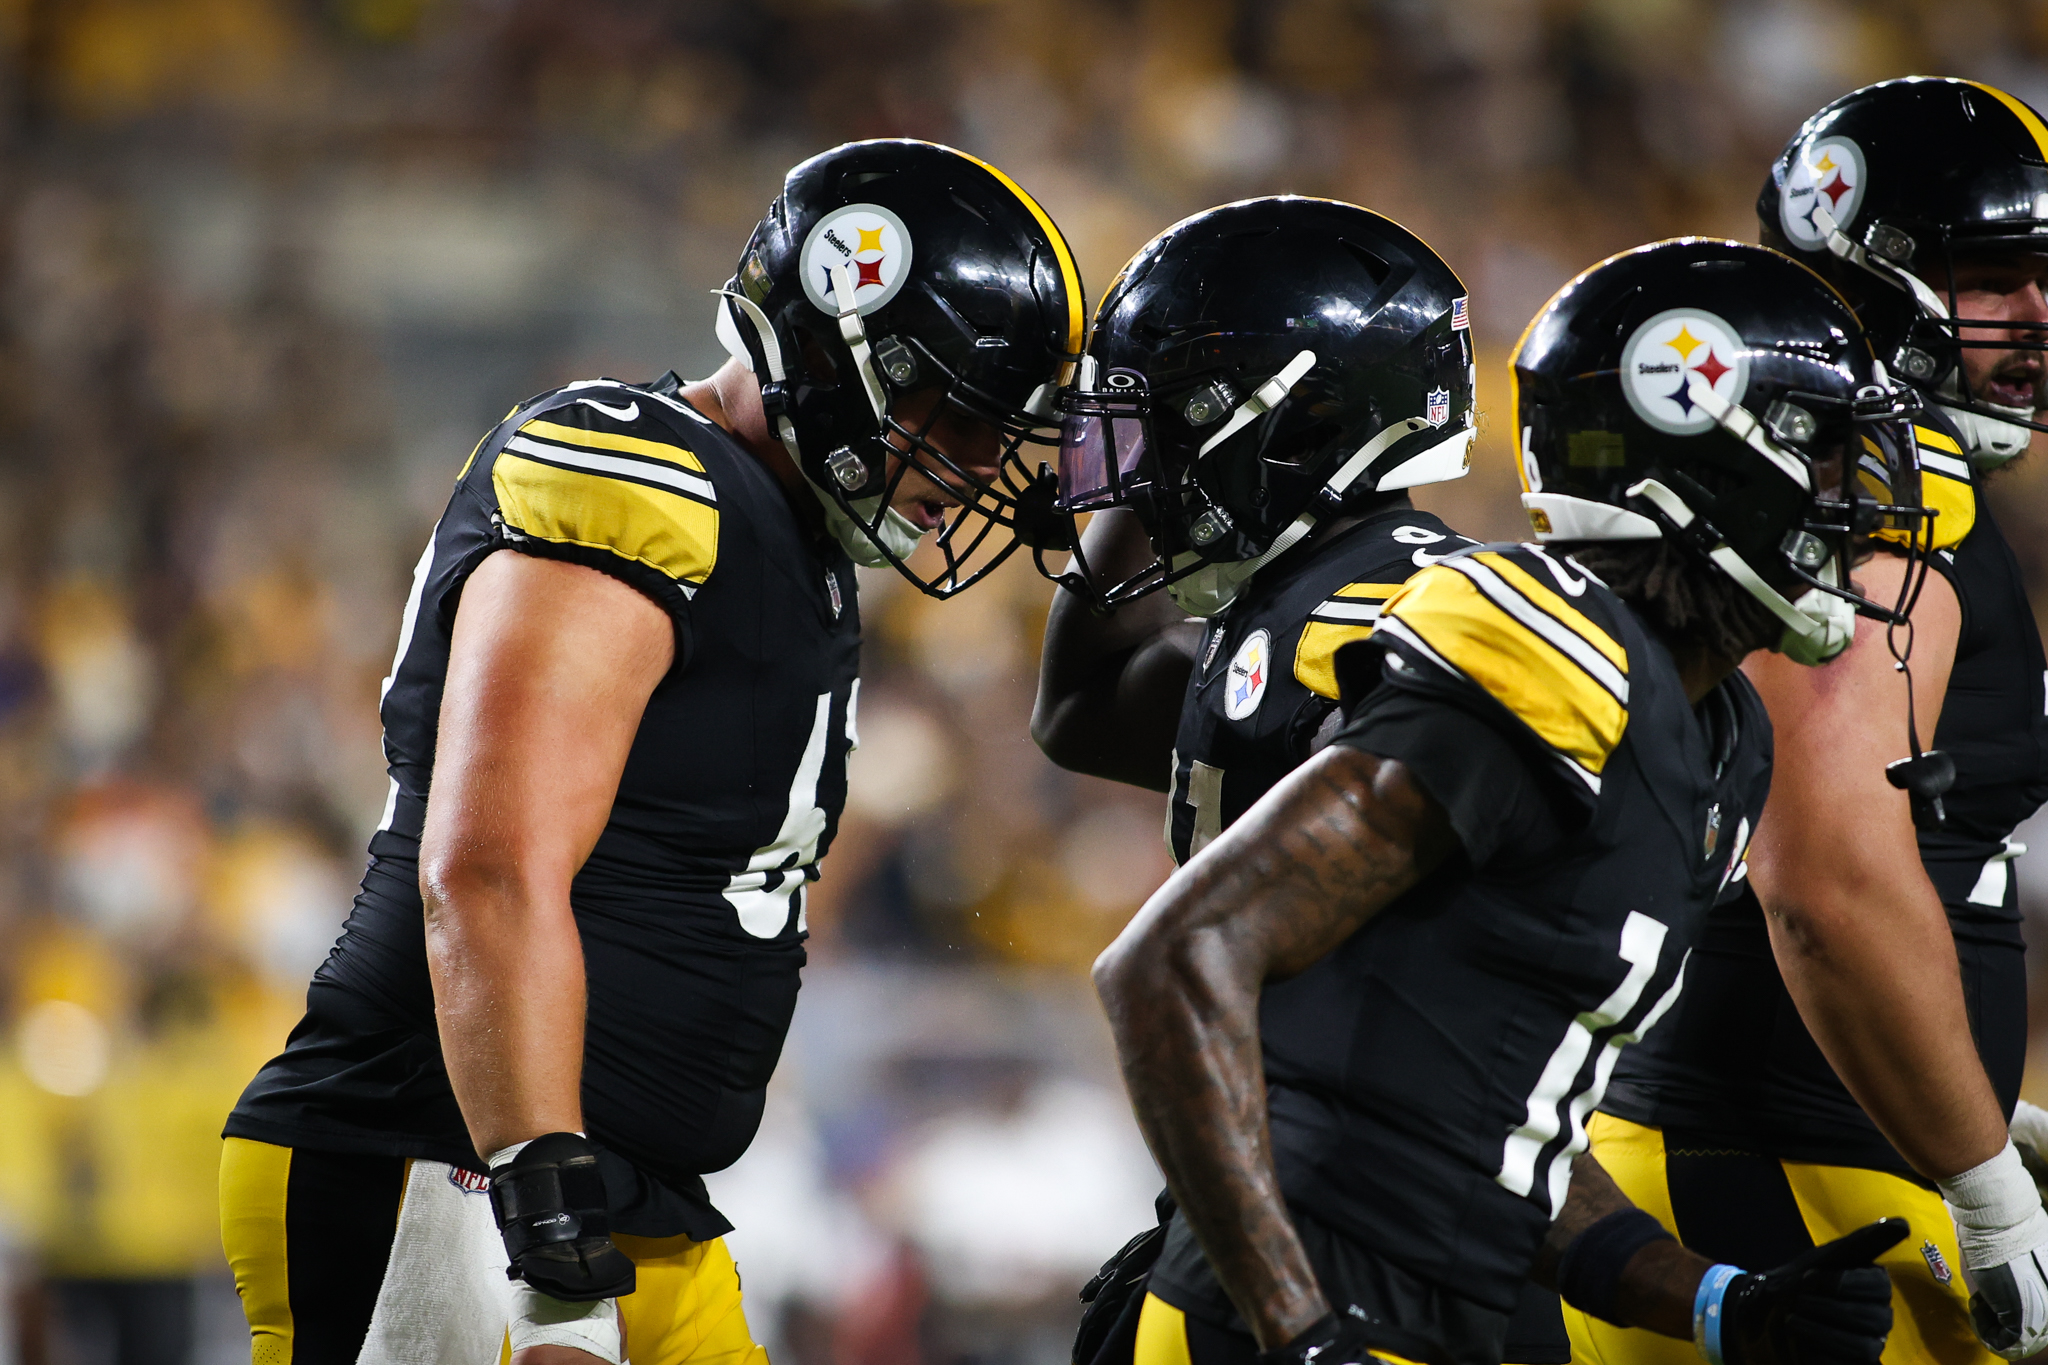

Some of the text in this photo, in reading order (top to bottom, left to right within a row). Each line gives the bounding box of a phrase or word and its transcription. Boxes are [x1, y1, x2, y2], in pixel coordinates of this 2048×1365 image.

[823, 229, 852, 257] Steelers
[1638, 361, 1680, 375] Steelers
[1431, 405, 1446, 422] NFL
[721, 677, 861, 939] 6
[452, 1168, 489, 1191] NFL
